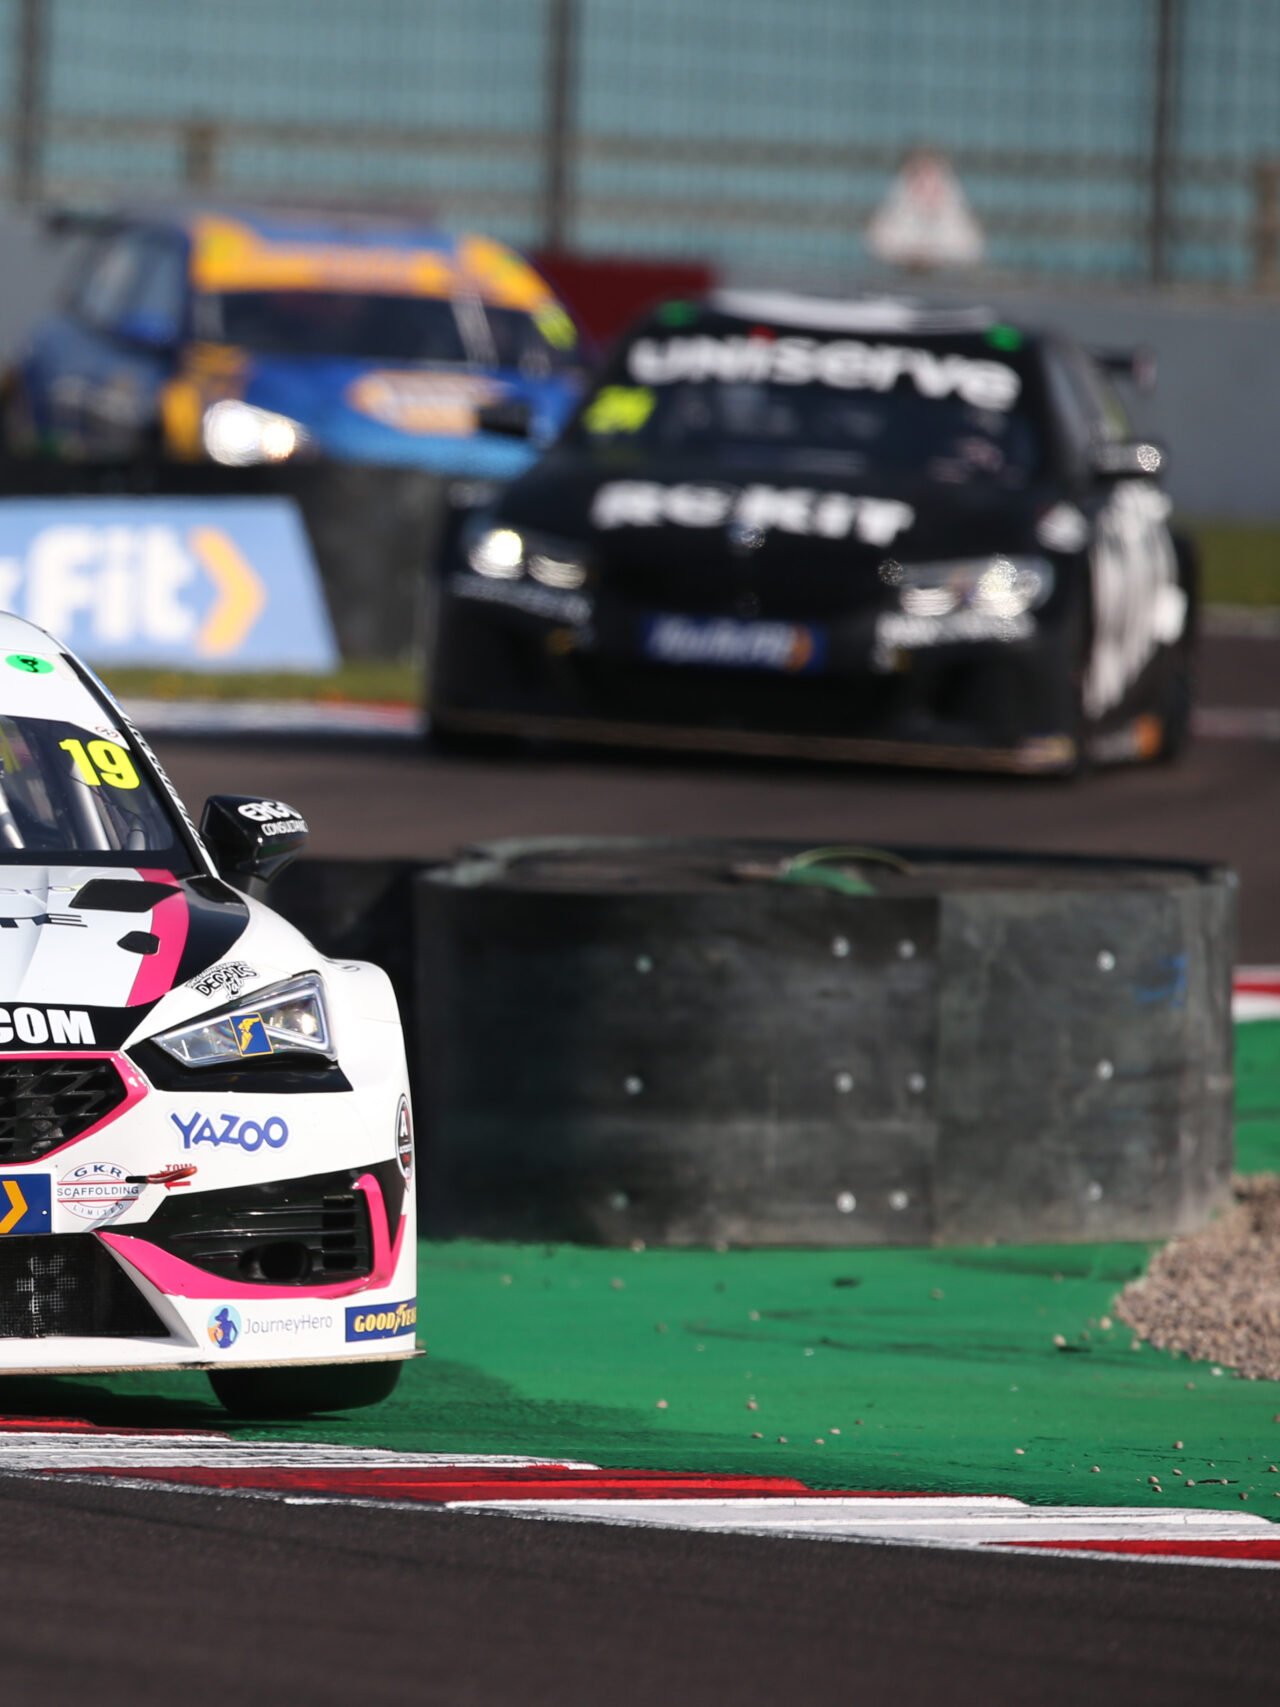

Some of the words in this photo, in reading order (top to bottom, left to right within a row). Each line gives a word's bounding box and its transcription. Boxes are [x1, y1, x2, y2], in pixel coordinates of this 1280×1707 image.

[58, 738, 140, 790] 19
[195, 964, 260, 997] DECALS
[170, 1111, 289, 1152] YAZOO
[74, 1164, 122, 1178] GKR
[57, 1186, 139, 1197] SCAFFOLDING
[73, 1202, 124, 1216] LIMITED
[244, 1315, 333, 1335] JourneyHero
